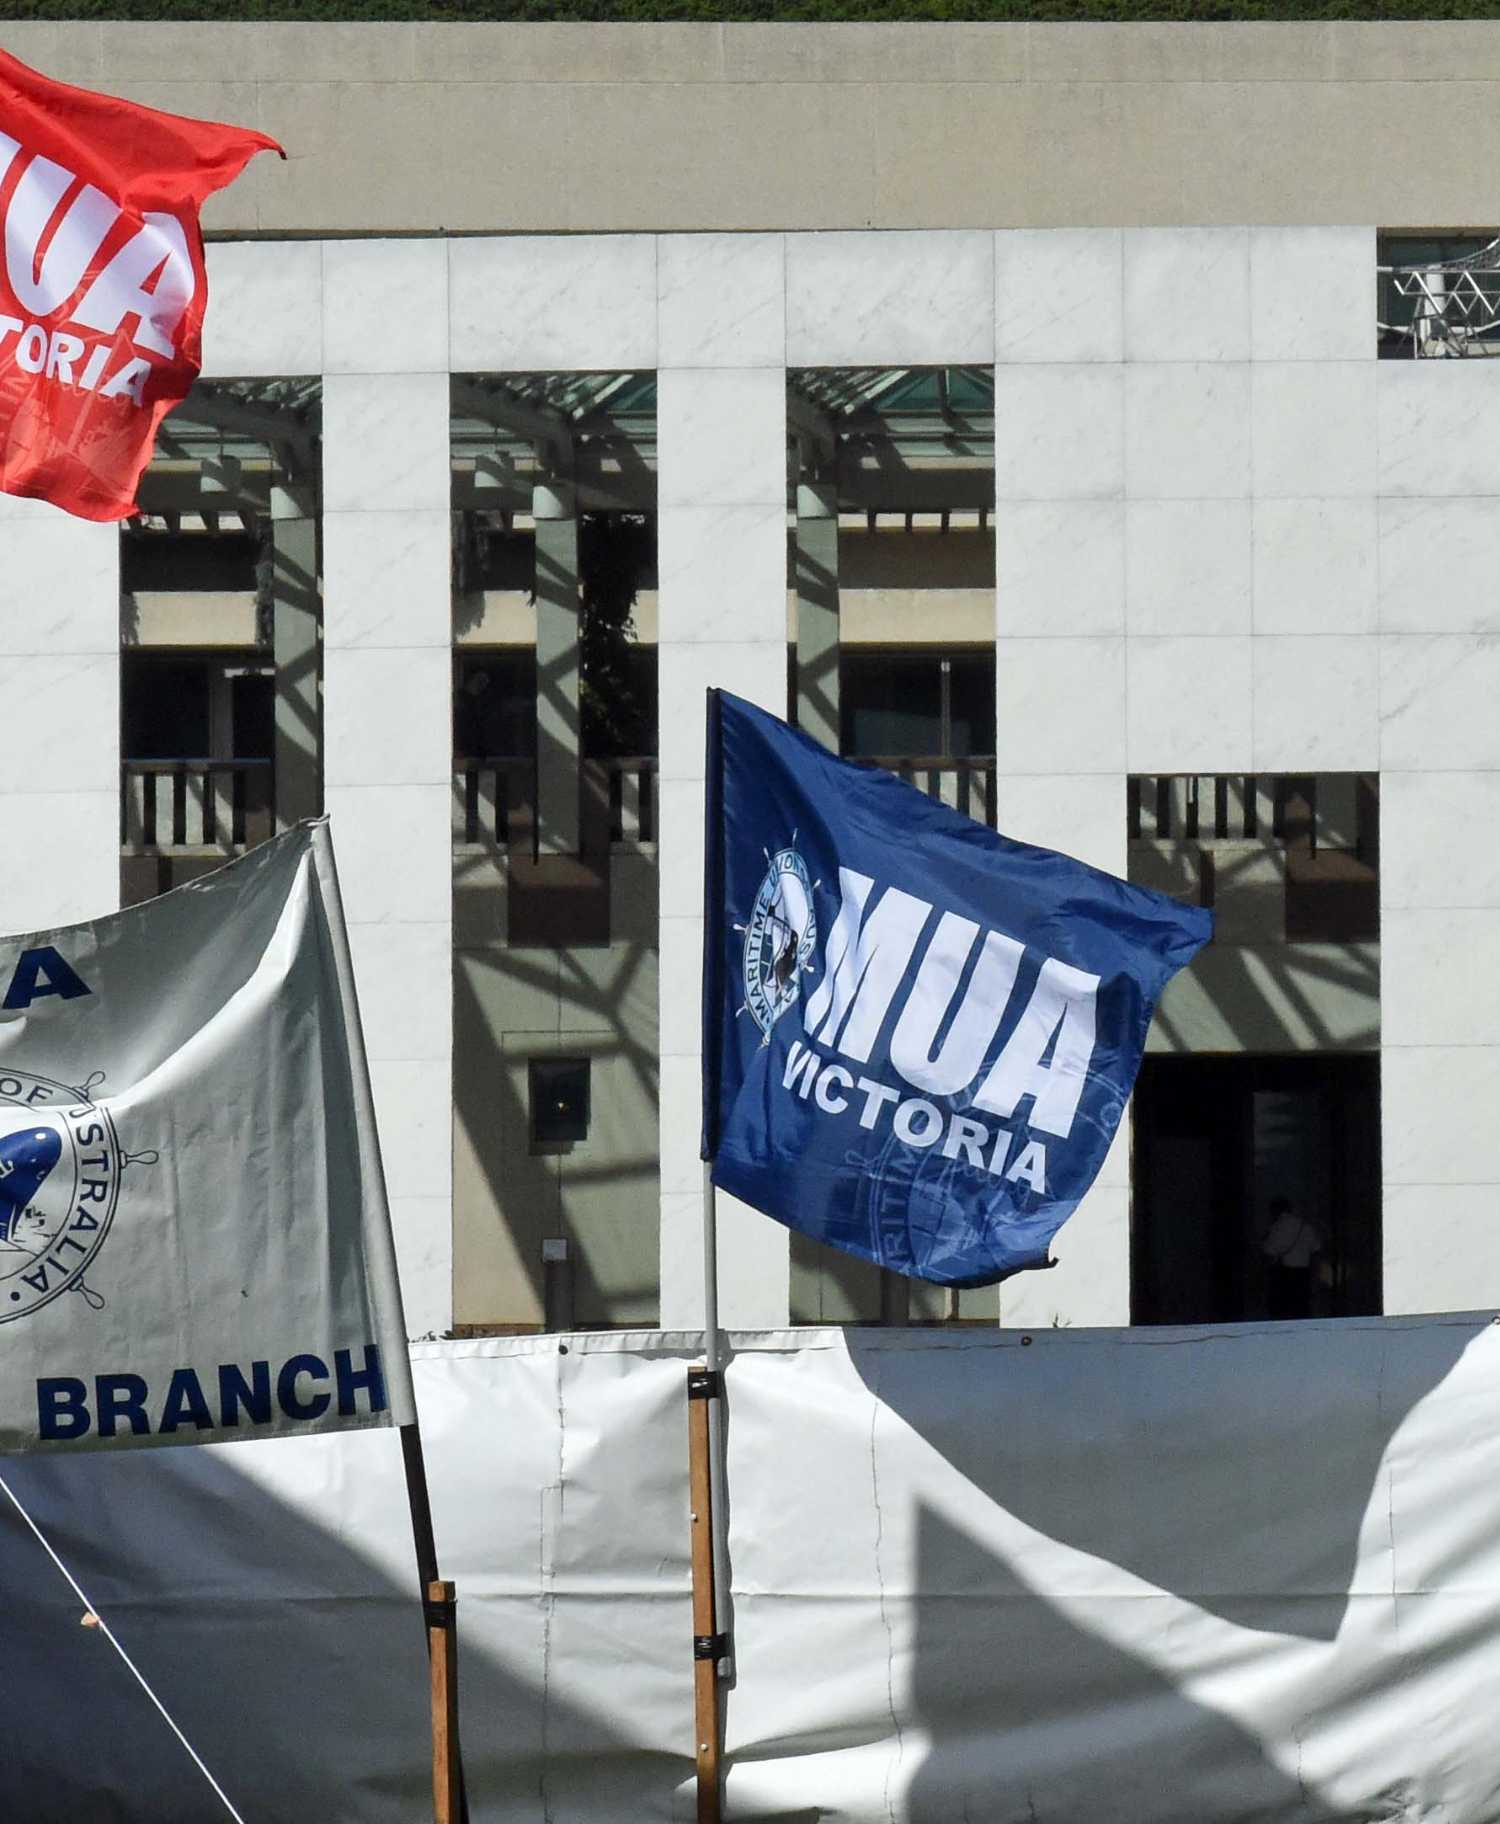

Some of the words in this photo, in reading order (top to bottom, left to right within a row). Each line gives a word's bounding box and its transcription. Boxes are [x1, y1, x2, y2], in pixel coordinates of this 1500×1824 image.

[0, 131, 195, 361] UA
[747, 893, 770, 1020] MARITIME
[803, 866, 1101, 1139] MUA
[0, 1077, 53, 1104] OF
[781, 1040, 1048, 1194] VICTORIA
[36, 1343, 388, 1441] BRANCH
